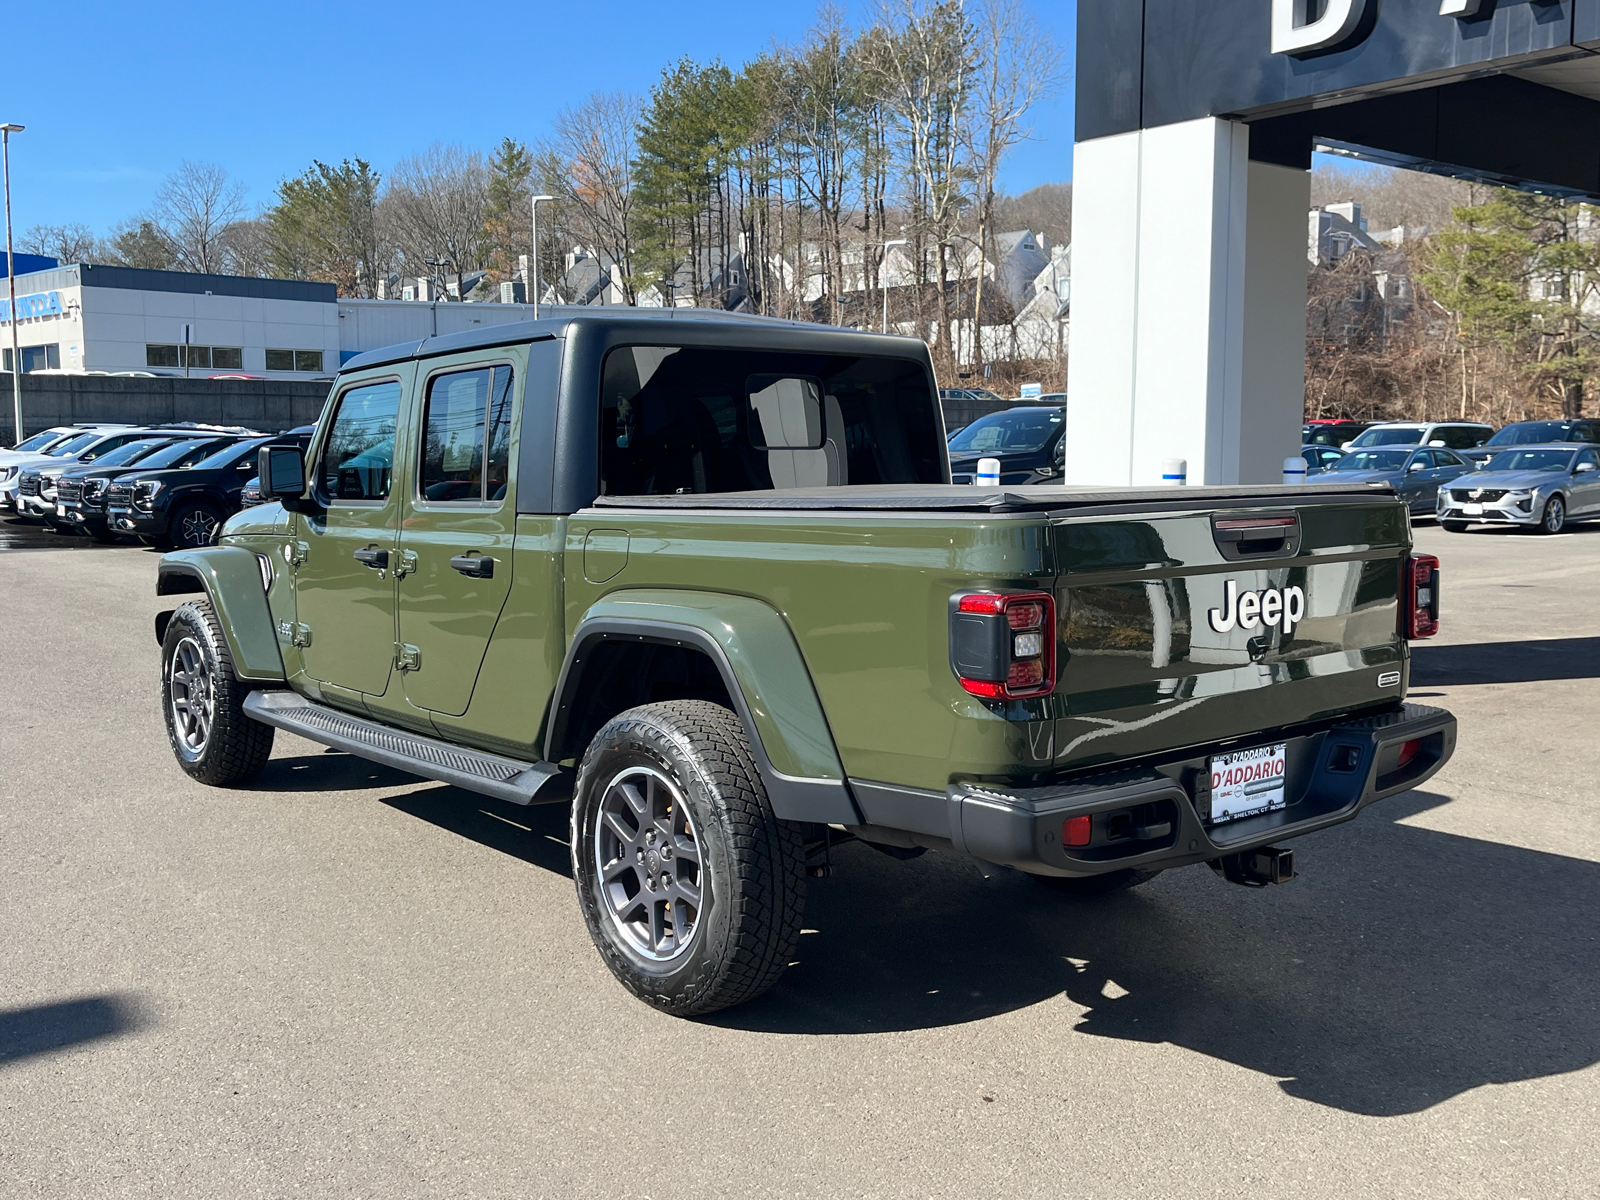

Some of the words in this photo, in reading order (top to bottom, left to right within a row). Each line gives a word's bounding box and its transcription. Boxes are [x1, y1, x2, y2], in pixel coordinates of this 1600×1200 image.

[1208, 579, 1304, 634] Jeep
[1232, 747, 1270, 763] D'ADDARIO
[1212, 758, 1284, 789] D'ADDARIO
